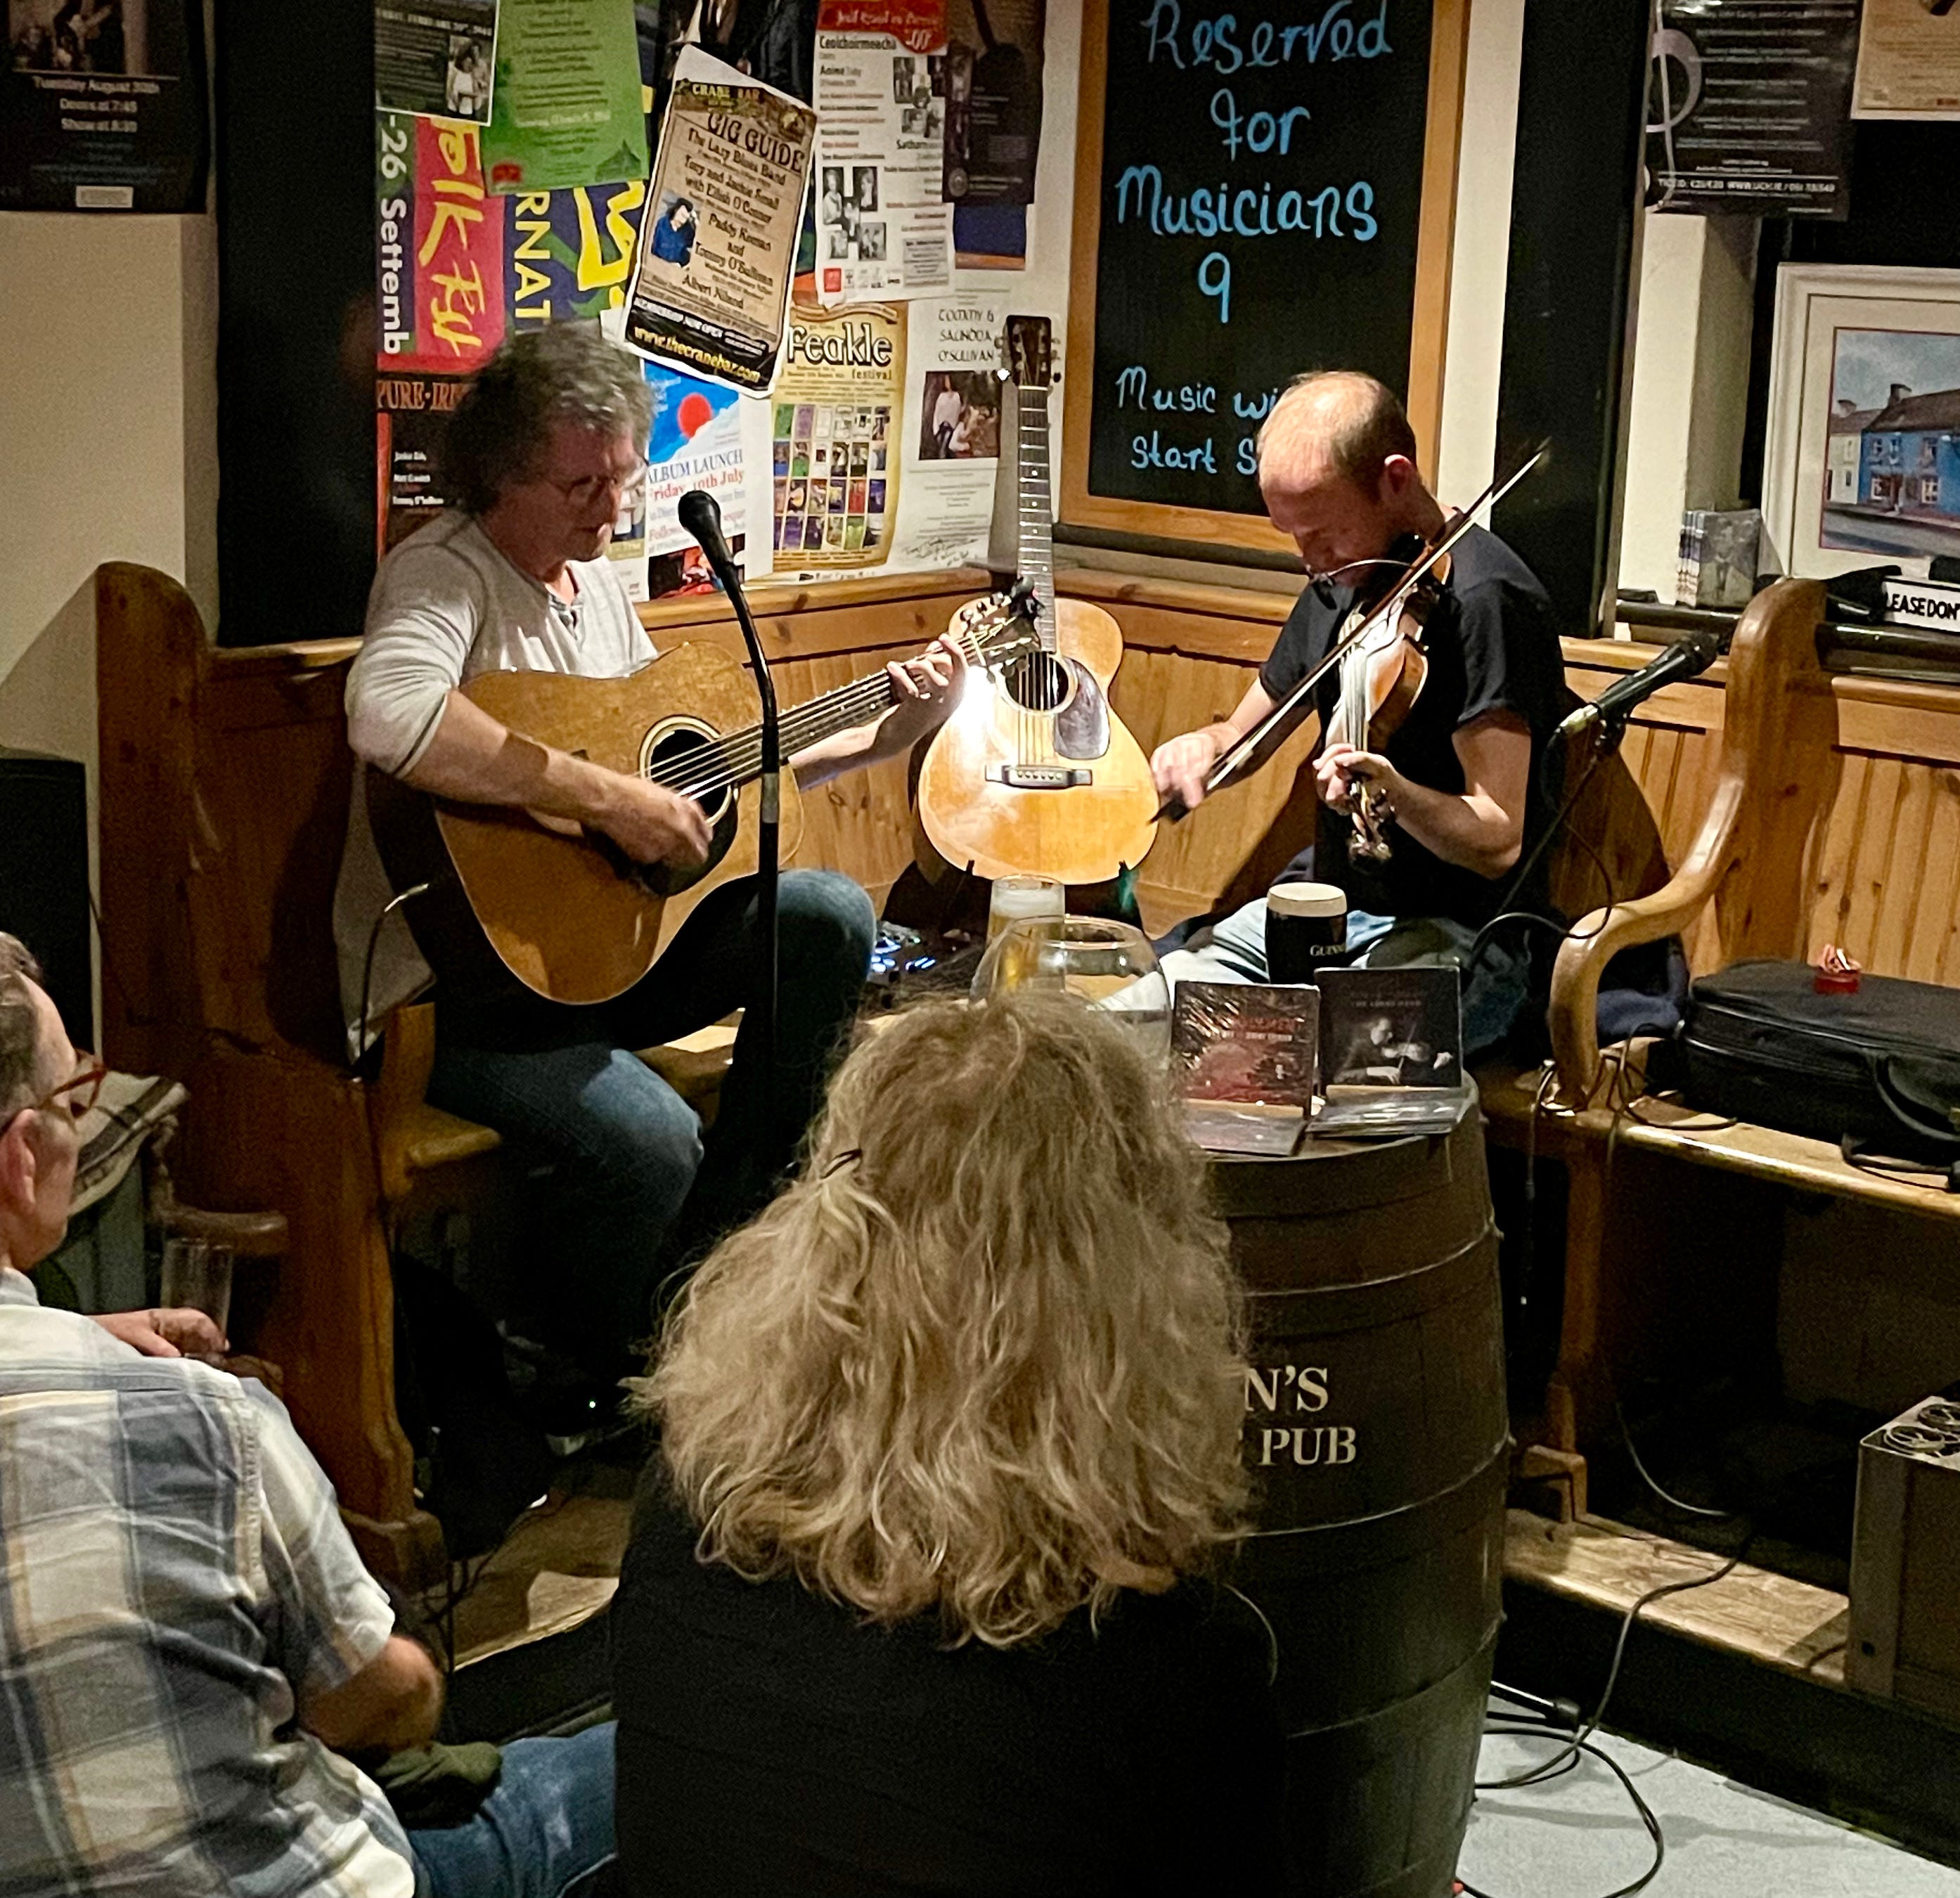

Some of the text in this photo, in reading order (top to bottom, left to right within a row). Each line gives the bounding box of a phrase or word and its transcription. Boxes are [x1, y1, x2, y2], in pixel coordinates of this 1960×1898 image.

[1140, 0, 1393, 73] Reserved
[707, 112, 806, 174] GIG GUIDE
[1210, 89, 1310, 162] for
[1115, 164, 1378, 241] Musicians
[1198, 252, 1232, 323] 9
[787, 321, 894, 367] Feakle
[851, 369, 892, 380] festival
[1115, 366, 1216, 415] Music
[693, 448, 744, 472] LAUNCH
[1257, 1426, 1357, 1466] PUB
